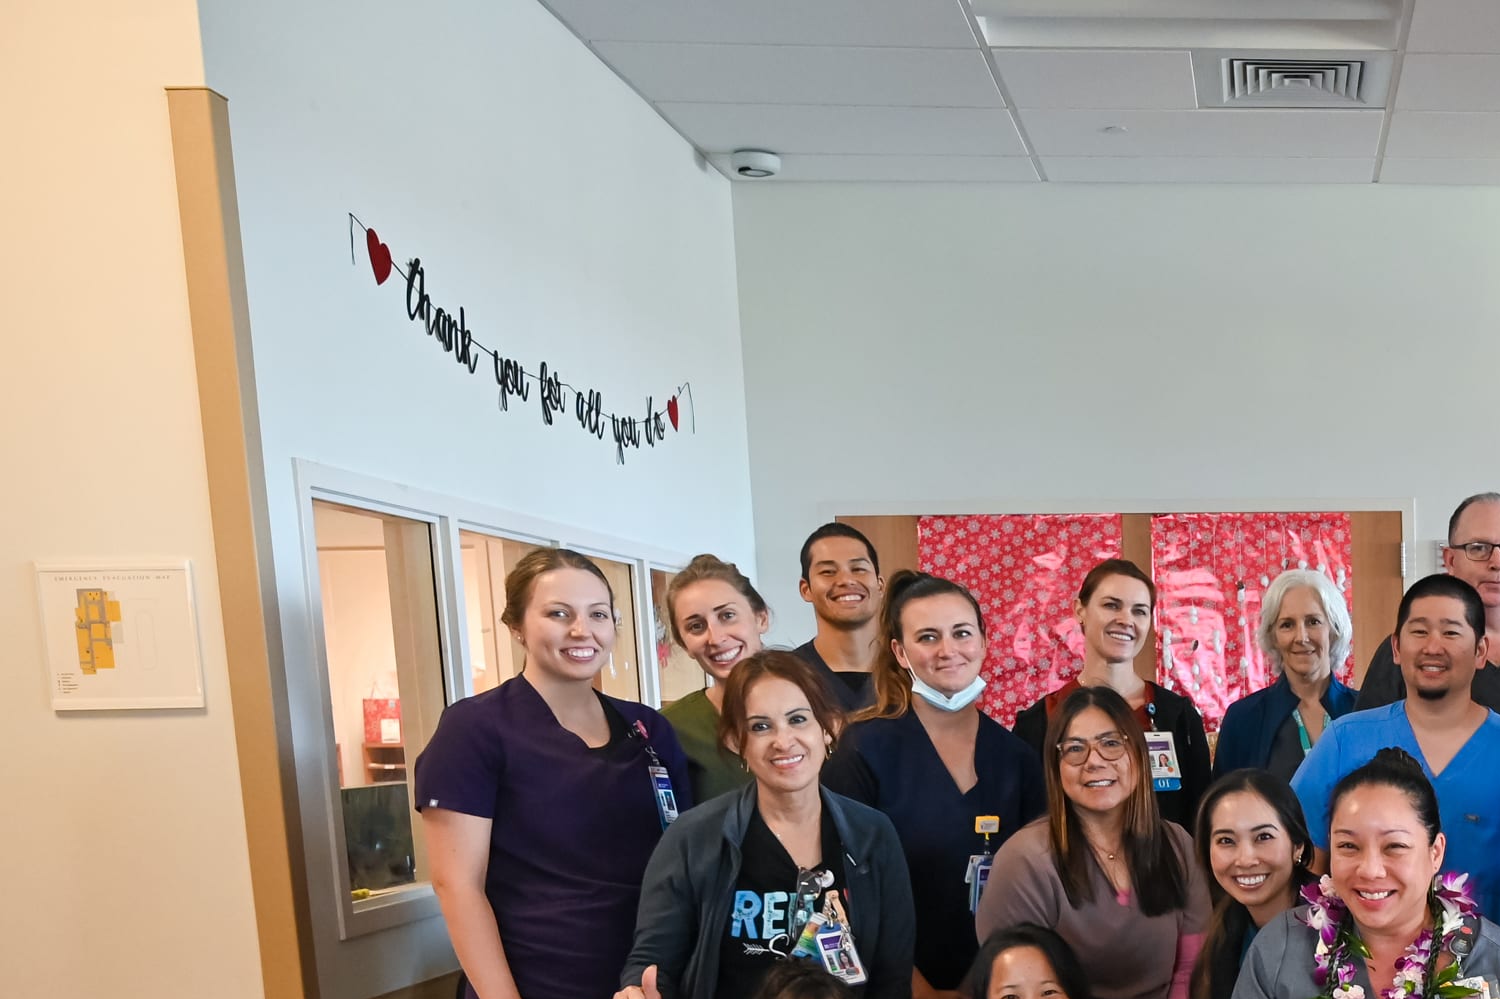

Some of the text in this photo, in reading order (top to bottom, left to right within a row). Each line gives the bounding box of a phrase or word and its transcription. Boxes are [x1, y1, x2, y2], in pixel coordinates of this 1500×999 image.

[406, 258, 665, 465] thank you for all you do
